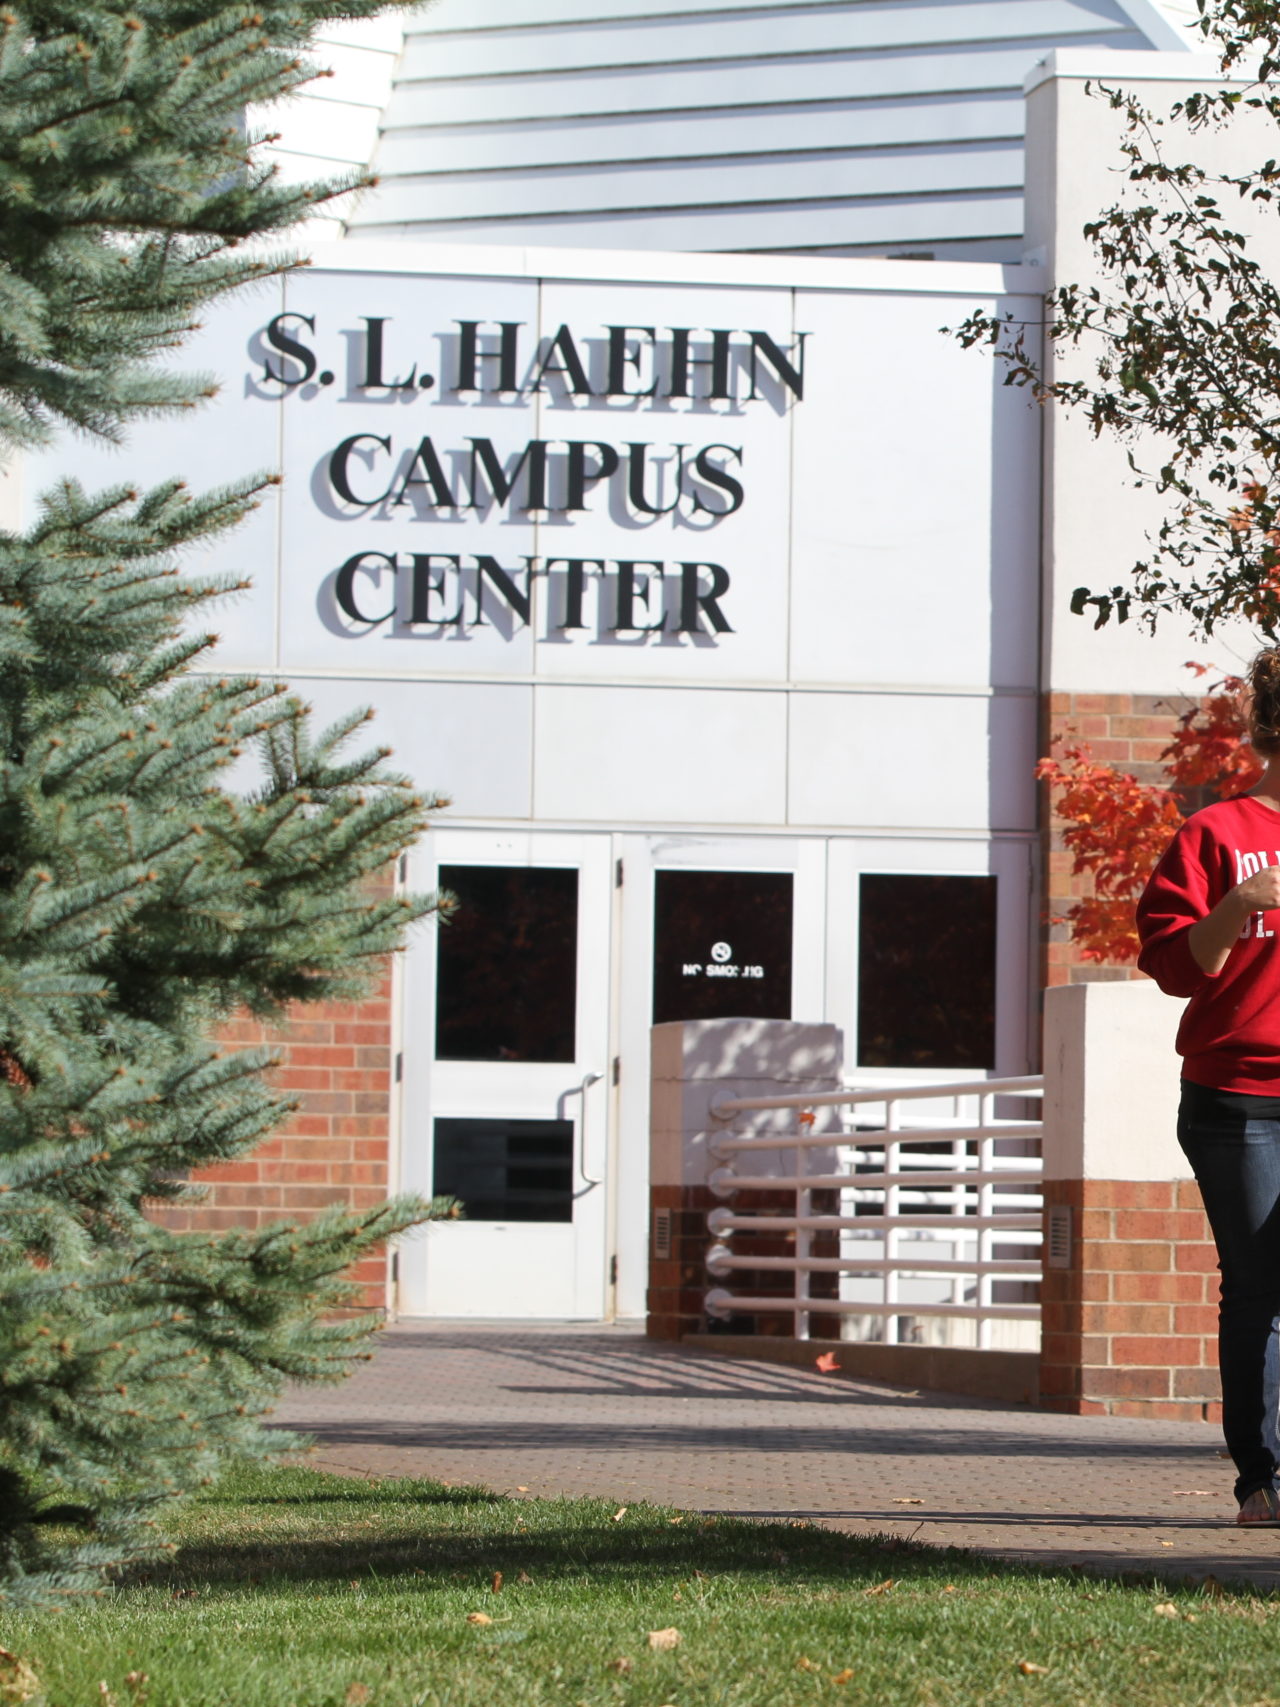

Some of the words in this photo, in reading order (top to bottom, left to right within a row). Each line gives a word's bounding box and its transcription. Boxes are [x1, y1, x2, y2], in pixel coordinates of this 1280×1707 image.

[450, 319, 814, 402] HAEHN
[328, 433, 745, 516] CAMPUS
[335, 550, 737, 634] CENTER
